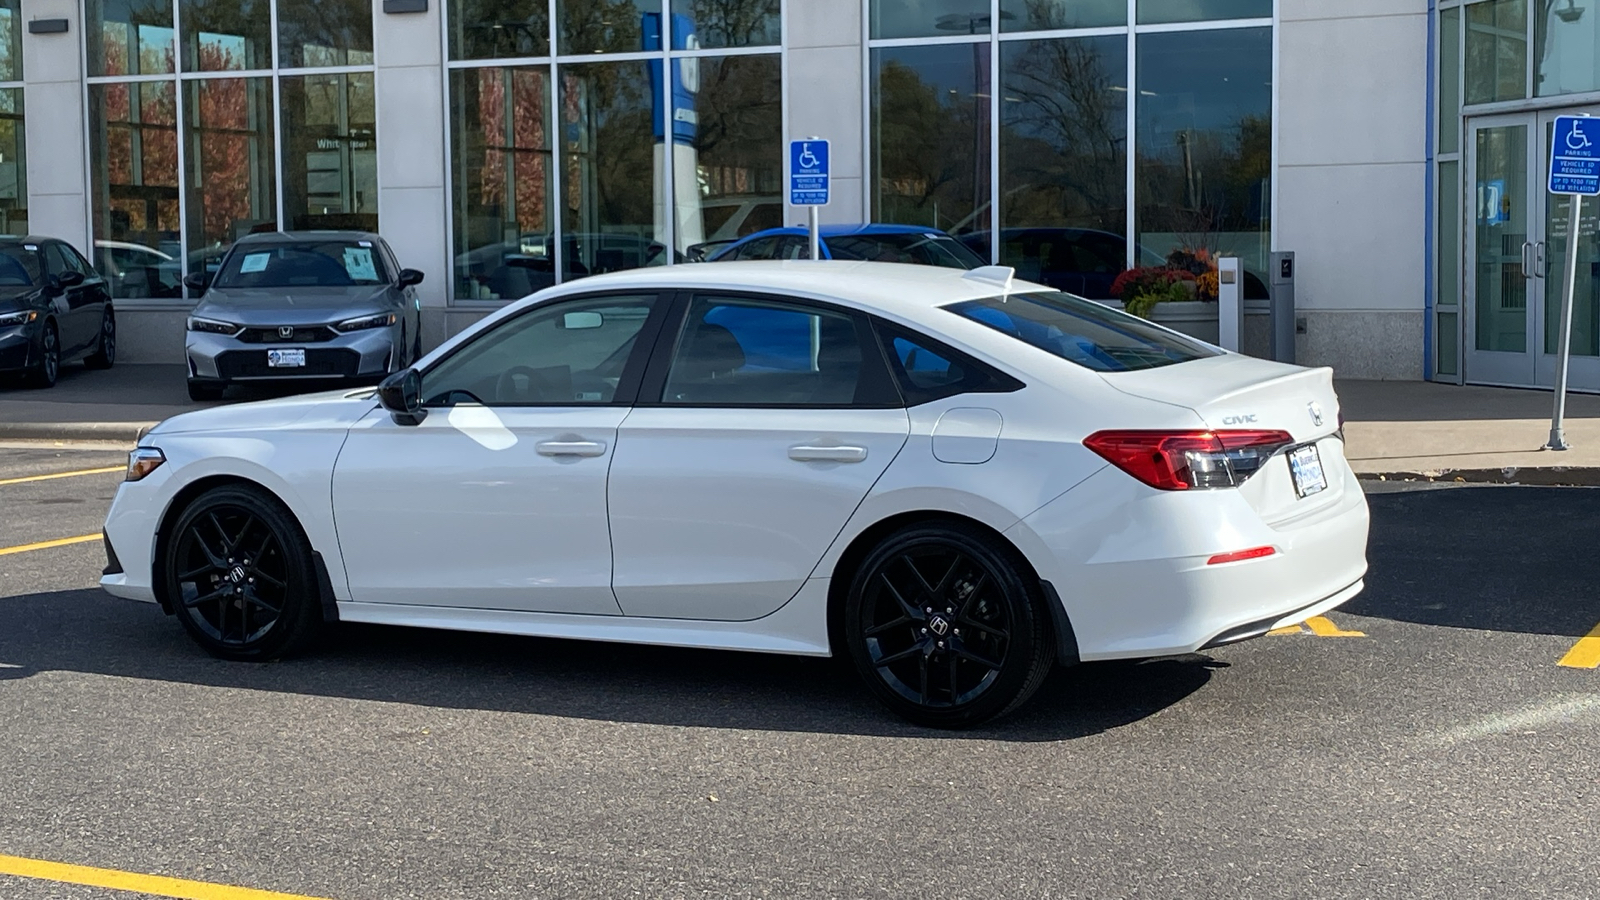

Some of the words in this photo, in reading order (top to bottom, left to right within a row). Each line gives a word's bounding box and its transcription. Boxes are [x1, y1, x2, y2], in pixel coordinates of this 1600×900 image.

[1565, 149, 1591, 157] PARKING
[1560, 160, 1585, 168] VEHICLE
[1222, 414, 1258, 425] CIVIC
